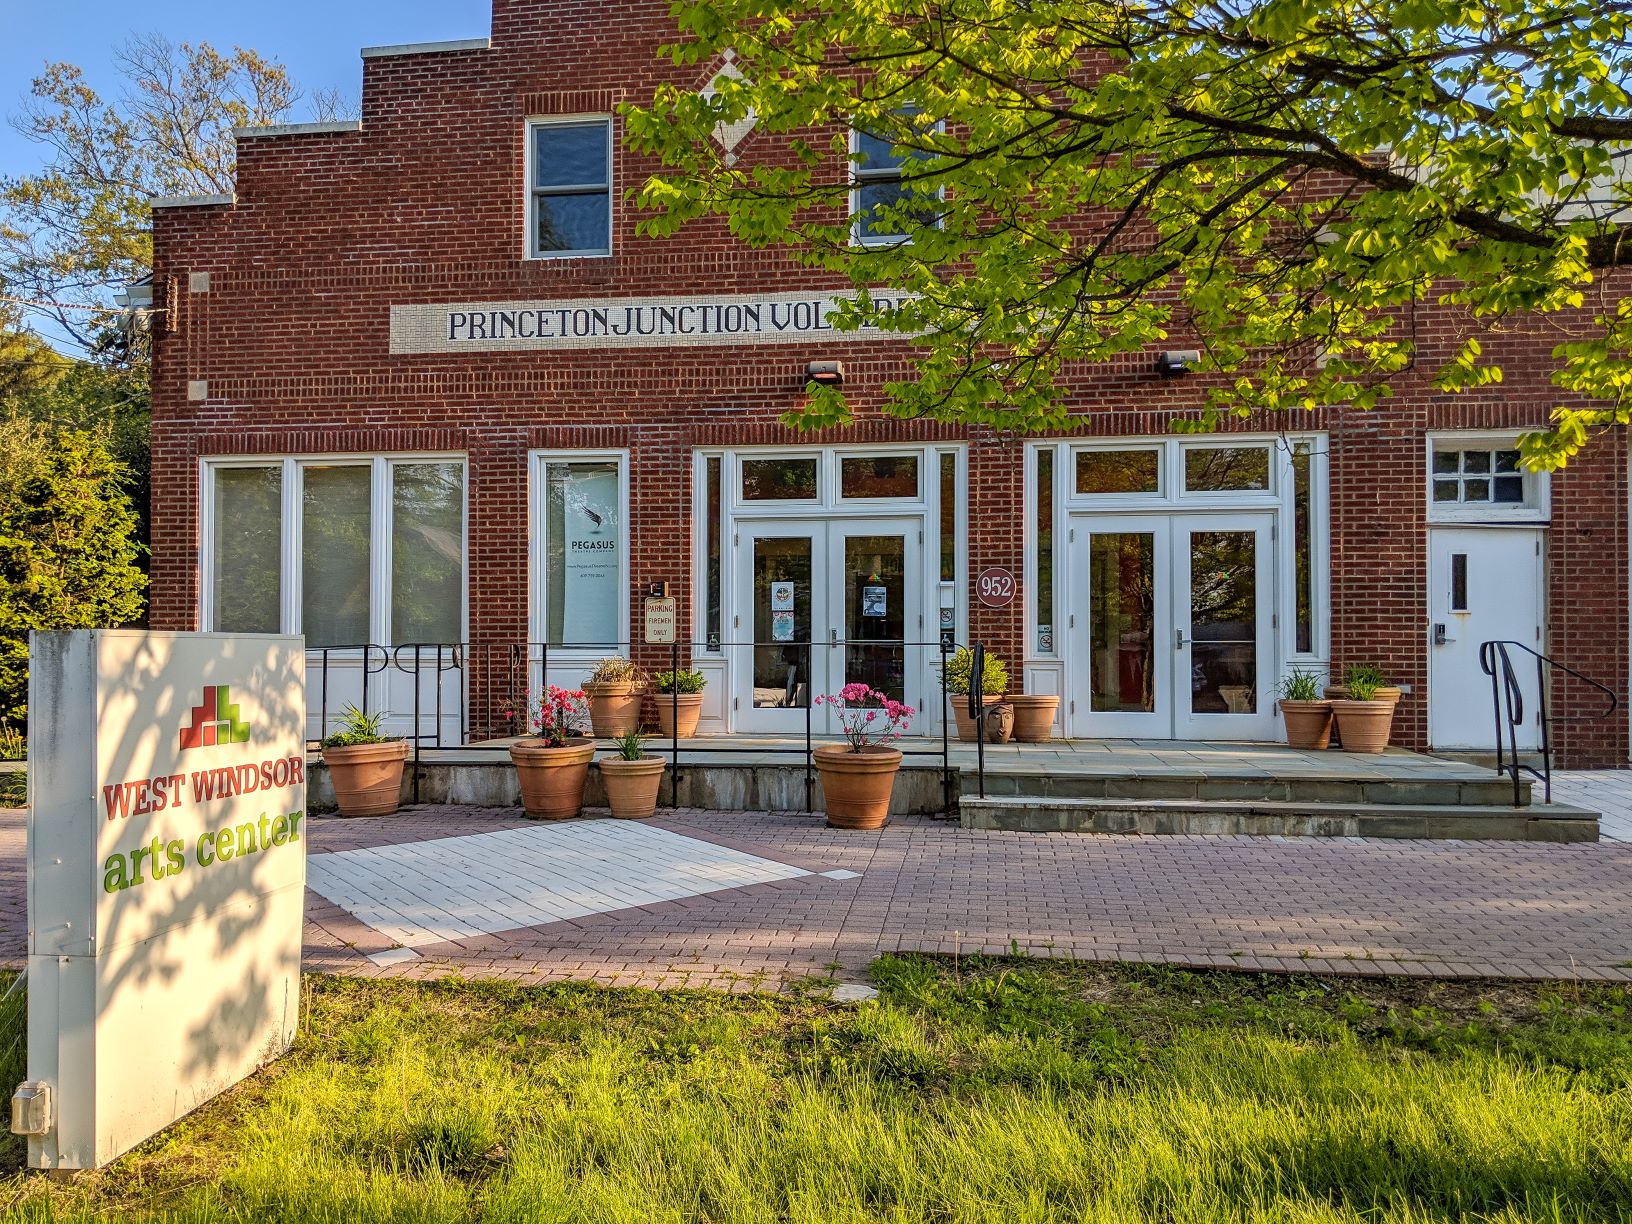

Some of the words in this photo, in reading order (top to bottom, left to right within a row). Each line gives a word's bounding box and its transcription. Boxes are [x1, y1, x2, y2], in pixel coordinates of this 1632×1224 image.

[448, 308, 610, 340] PRINCETON
[611, 303, 762, 336] JUNCTION
[571, 541, 615, 549] PEGASUS
[981, 576, 1012, 597] 952
[647, 604, 673, 613] PARKING
[648, 617, 672, 625] FIREMEN
[103, 773, 186, 821] WEST
[191, 756, 304, 803] WINDSOR
[104, 835, 186, 893] arts
[196, 810, 304, 868] center
